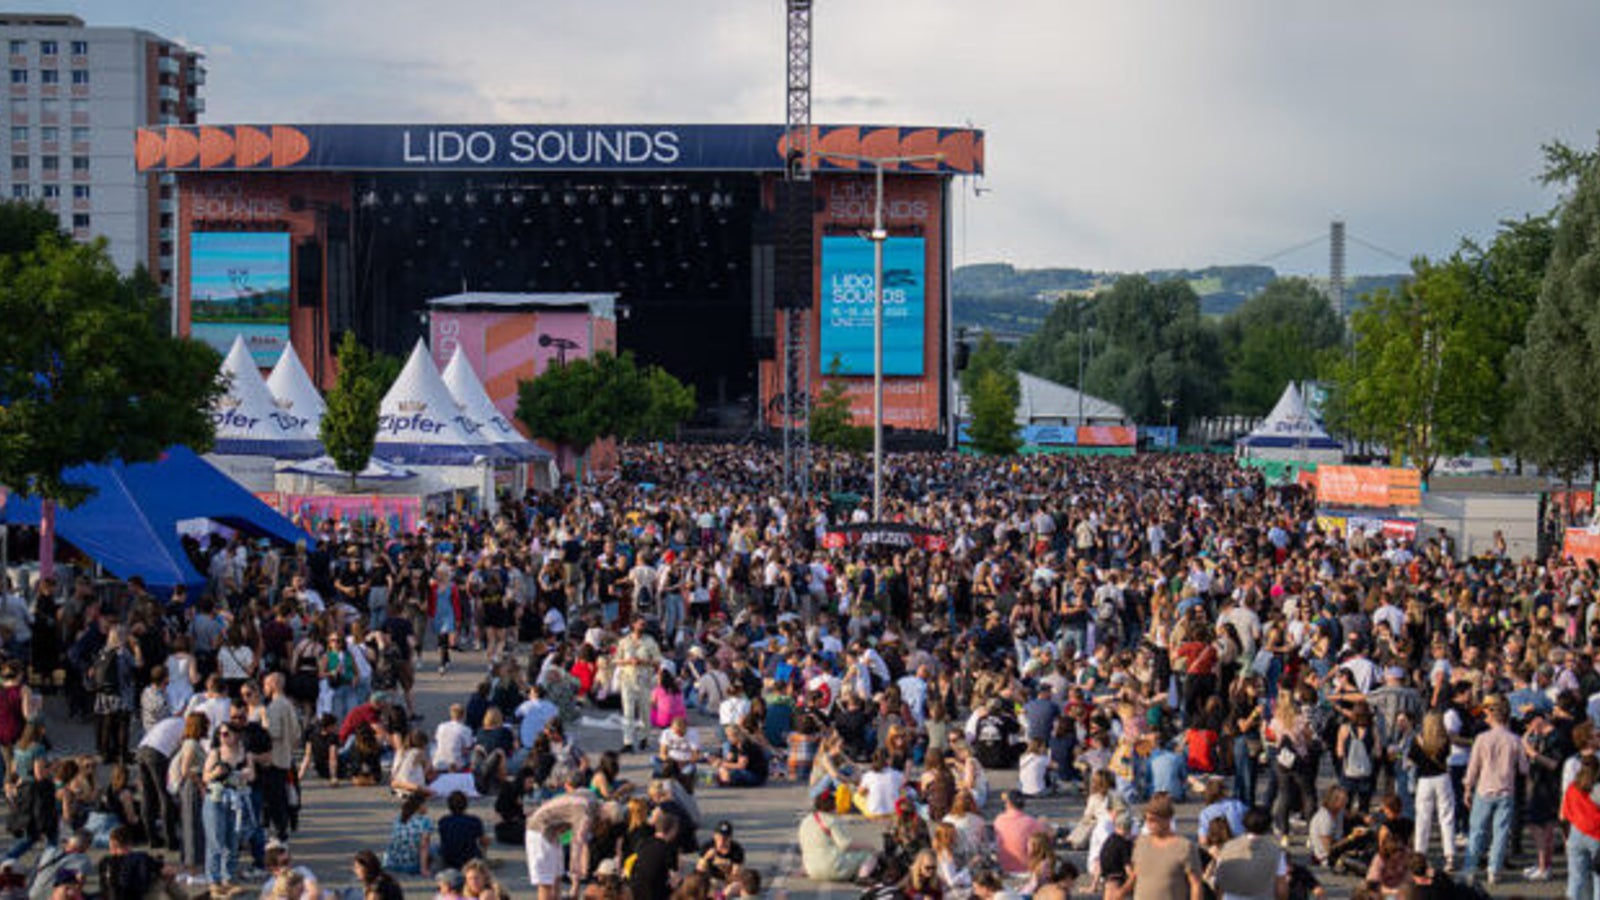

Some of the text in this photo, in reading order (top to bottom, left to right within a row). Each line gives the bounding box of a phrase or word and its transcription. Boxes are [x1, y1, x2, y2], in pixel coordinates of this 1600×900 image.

[403, 131, 680, 163] LIDO SOUNDS
[832, 273, 874, 289] LIDO
